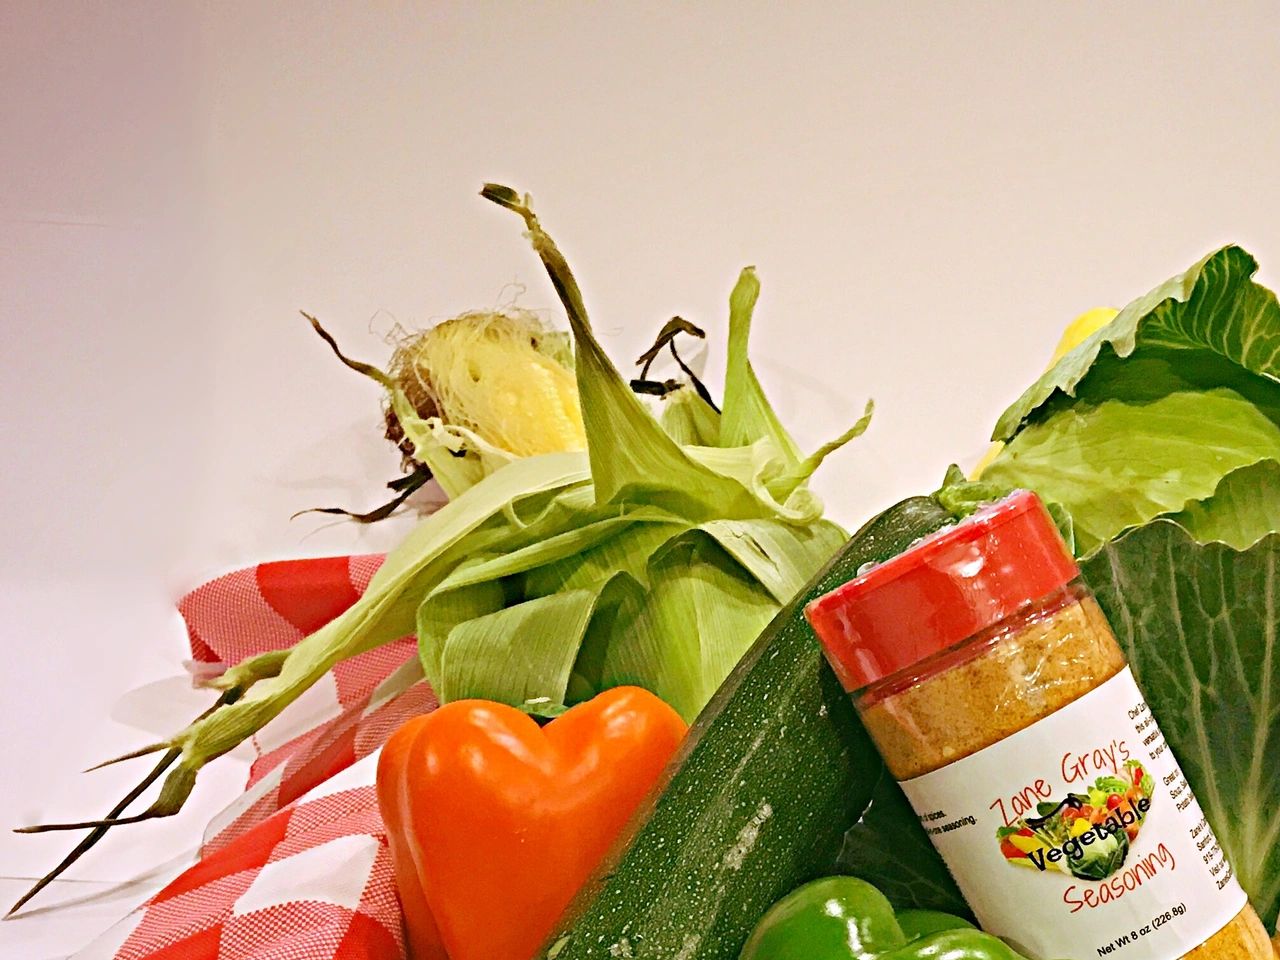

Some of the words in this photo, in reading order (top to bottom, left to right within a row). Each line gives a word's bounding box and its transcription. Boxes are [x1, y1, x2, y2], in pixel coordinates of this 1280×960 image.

[989, 779, 1052, 827] Zane
[1061, 739, 1130, 783] Gray's
[1027, 796, 1151, 872] Vegetable
[1062, 842, 1176, 914] Seasoning
[1096, 943, 1116, 958] Net
[1114, 935, 1131, 948] Wt
[1130, 930, 1139, 941] 8
[1139, 925, 1152, 936] oz
[1151, 902, 1187, 931] (226.8g)
